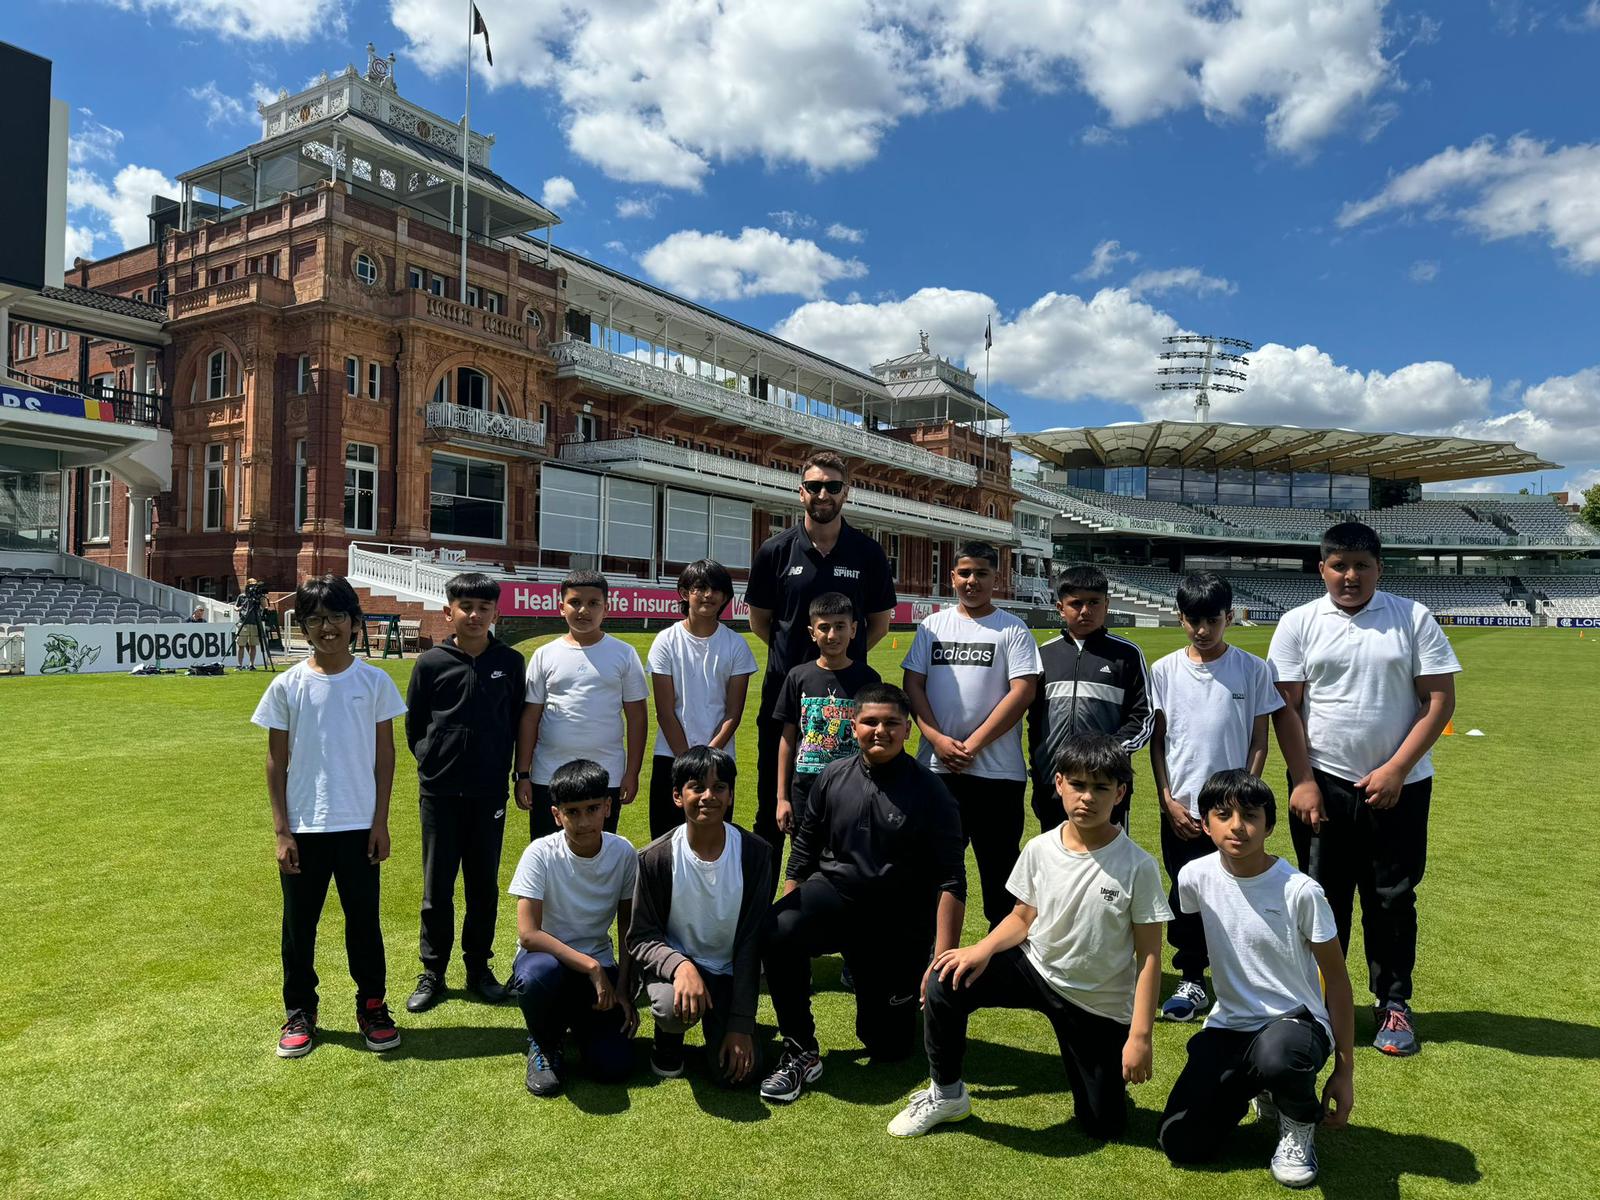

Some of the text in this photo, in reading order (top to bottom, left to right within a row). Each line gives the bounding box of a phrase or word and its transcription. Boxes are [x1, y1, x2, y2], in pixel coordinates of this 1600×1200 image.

[833, 569, 860, 579] SPIRIT
[607, 591, 629, 612] ife
[1439, 616, 1454, 624] THE
[116, 631, 237, 664] HOBGOBLI
[933, 646, 992, 661] adidas
